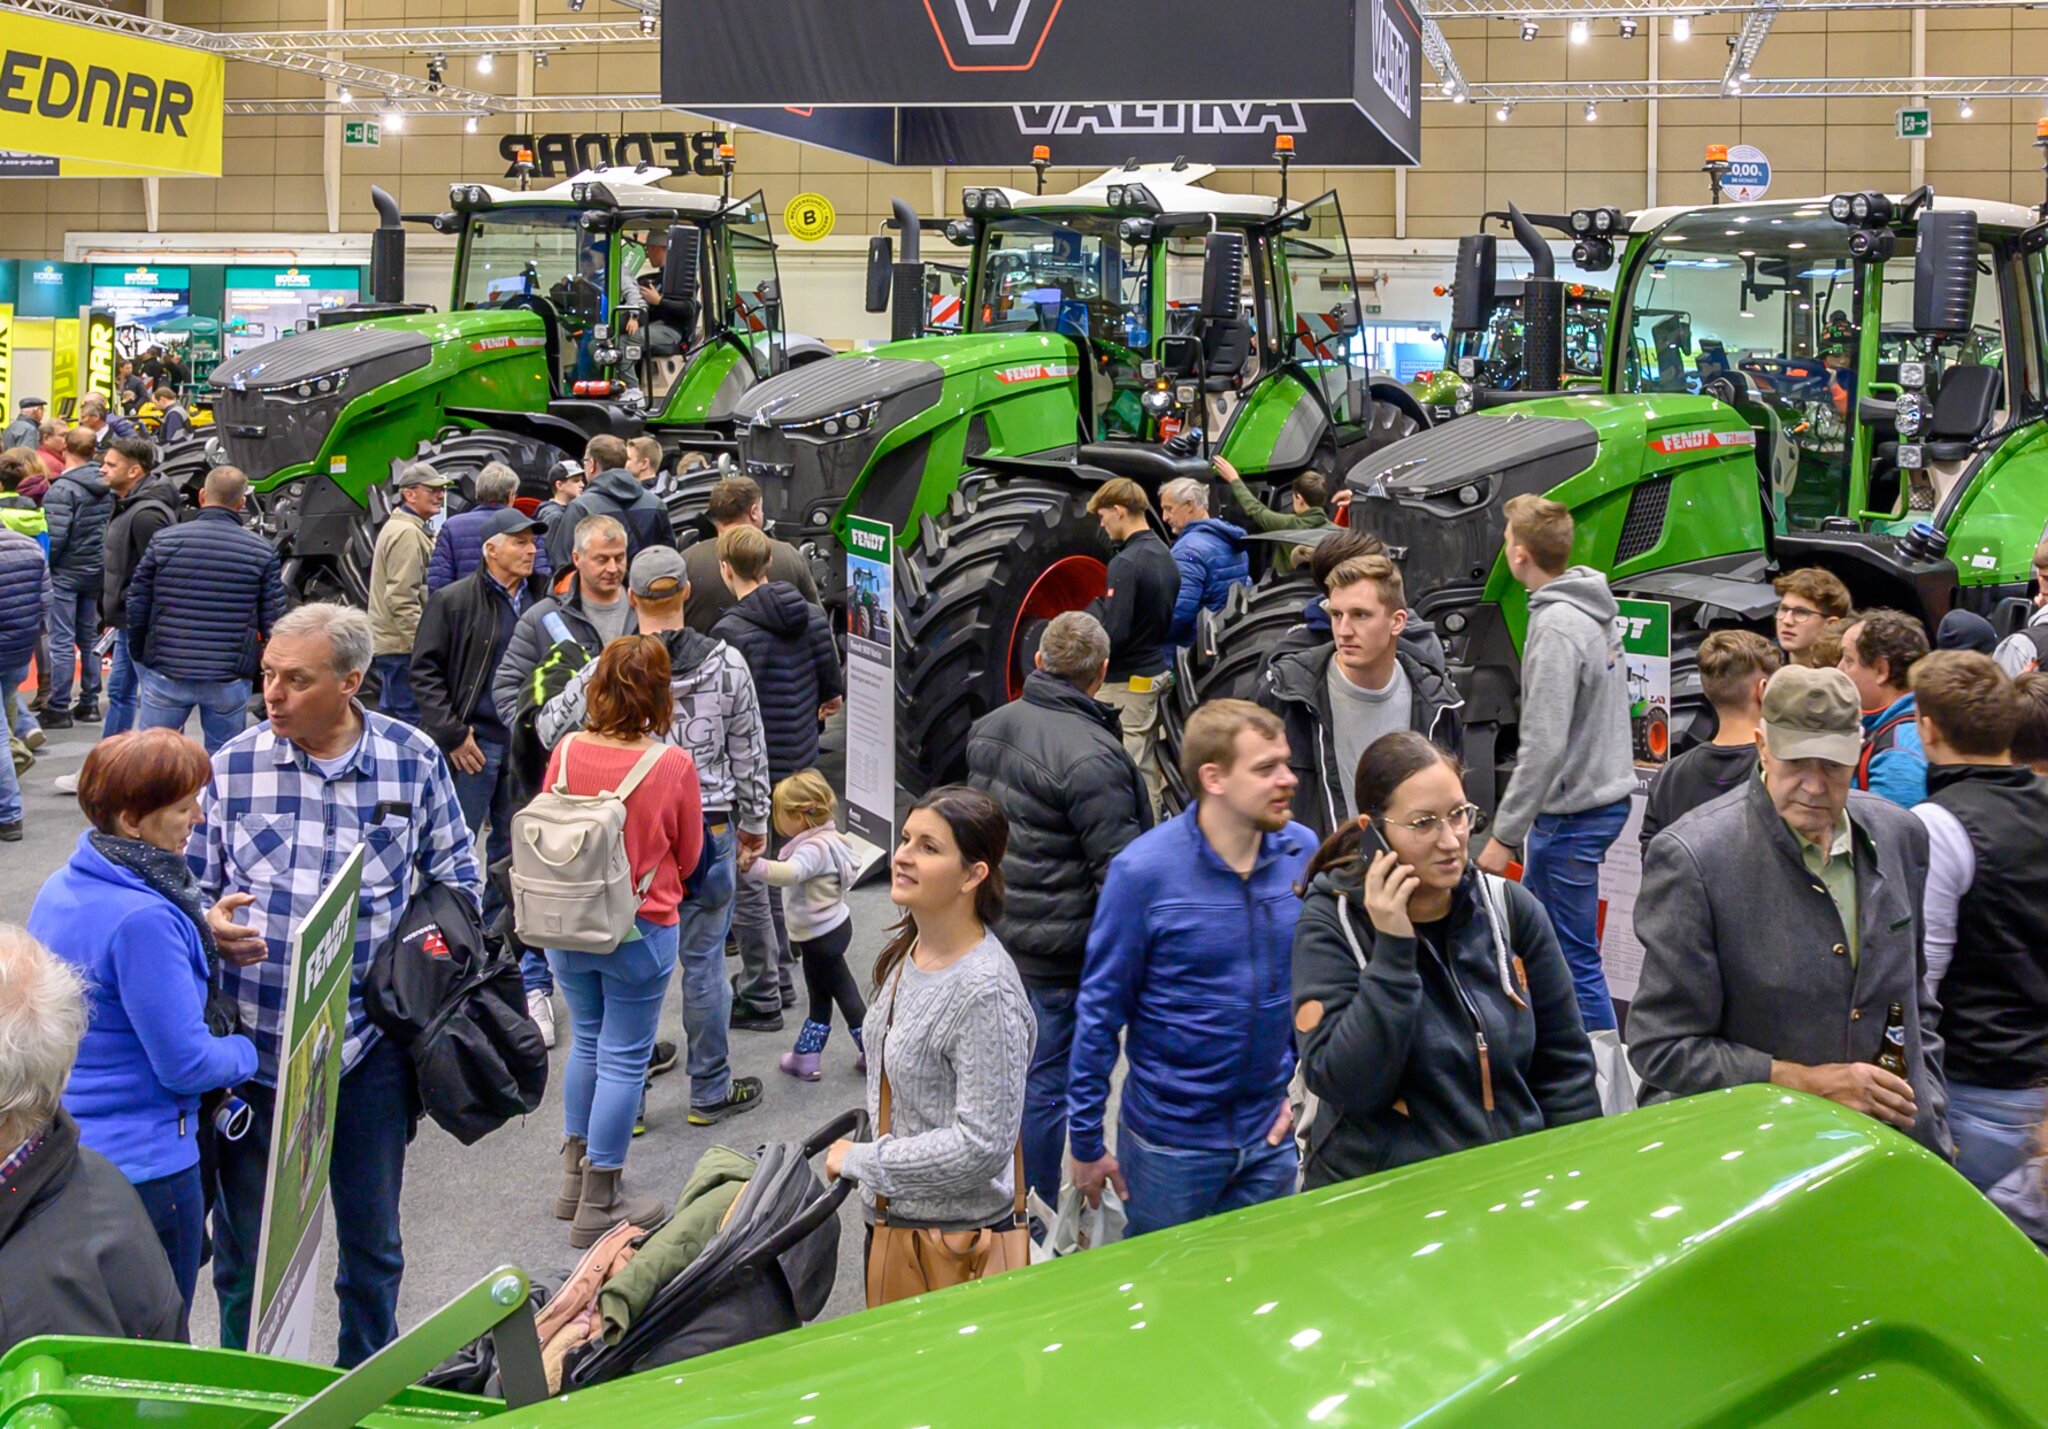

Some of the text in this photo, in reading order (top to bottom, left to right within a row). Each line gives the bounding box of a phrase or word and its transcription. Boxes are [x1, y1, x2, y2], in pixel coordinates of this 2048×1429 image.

[803, 210, 816, 225] B
[1005, 364, 1041, 381] FENDT
[1662, 429, 1711, 451] FENDT
[851, 528, 886, 552] FENDT
[303, 890, 356, 1005] FENDT
